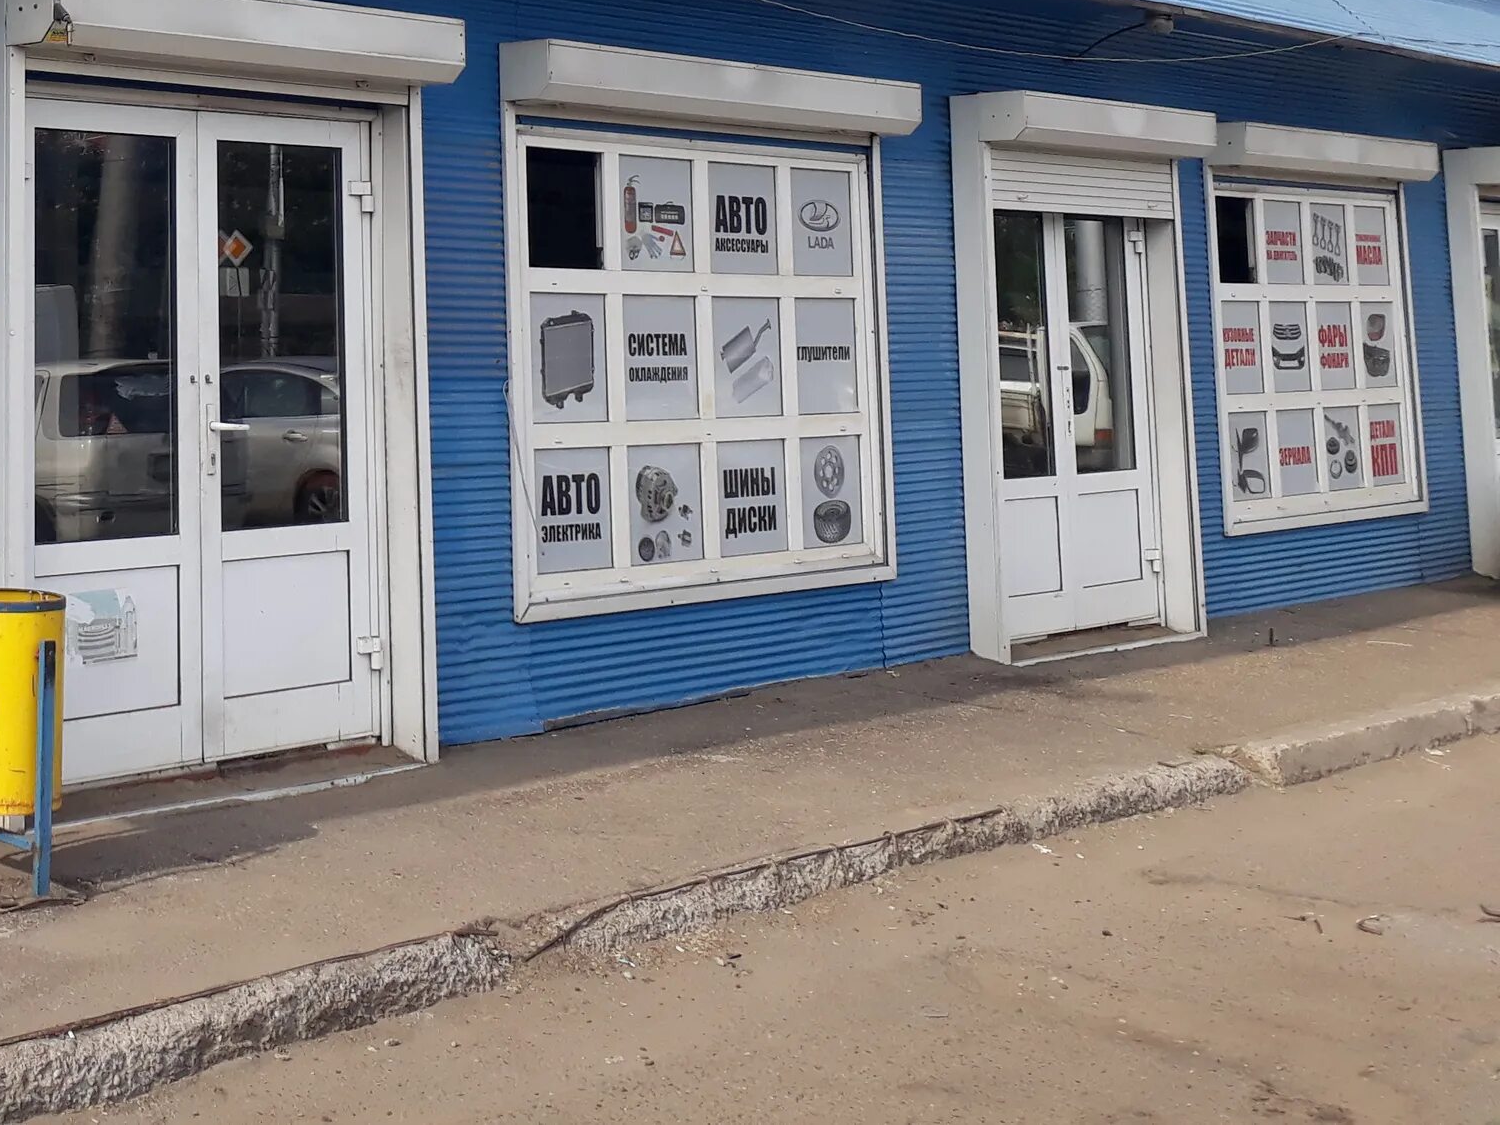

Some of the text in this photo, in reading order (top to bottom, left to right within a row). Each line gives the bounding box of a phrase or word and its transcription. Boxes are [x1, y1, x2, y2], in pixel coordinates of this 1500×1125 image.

[715, 194, 767, 235] АВТО
[715, 237, 769, 254] АКСЕССУАРЫ
[807, 236, 835, 250] LADA
[628, 332, 687, 357] СИСТЕМА
[1318, 325, 1347, 347] ФАРЫ
[628, 366, 688, 383] ОХЛАЖДЕНИЯ
[1371, 443, 1398, 477] КПП
[541, 472, 600, 516] АВТО
[723, 467, 776, 499] ШИНЫ
[541, 522, 601, 542] ЭЛЕКТРИКА
[725, 505, 777, 539] ДИСКИ
